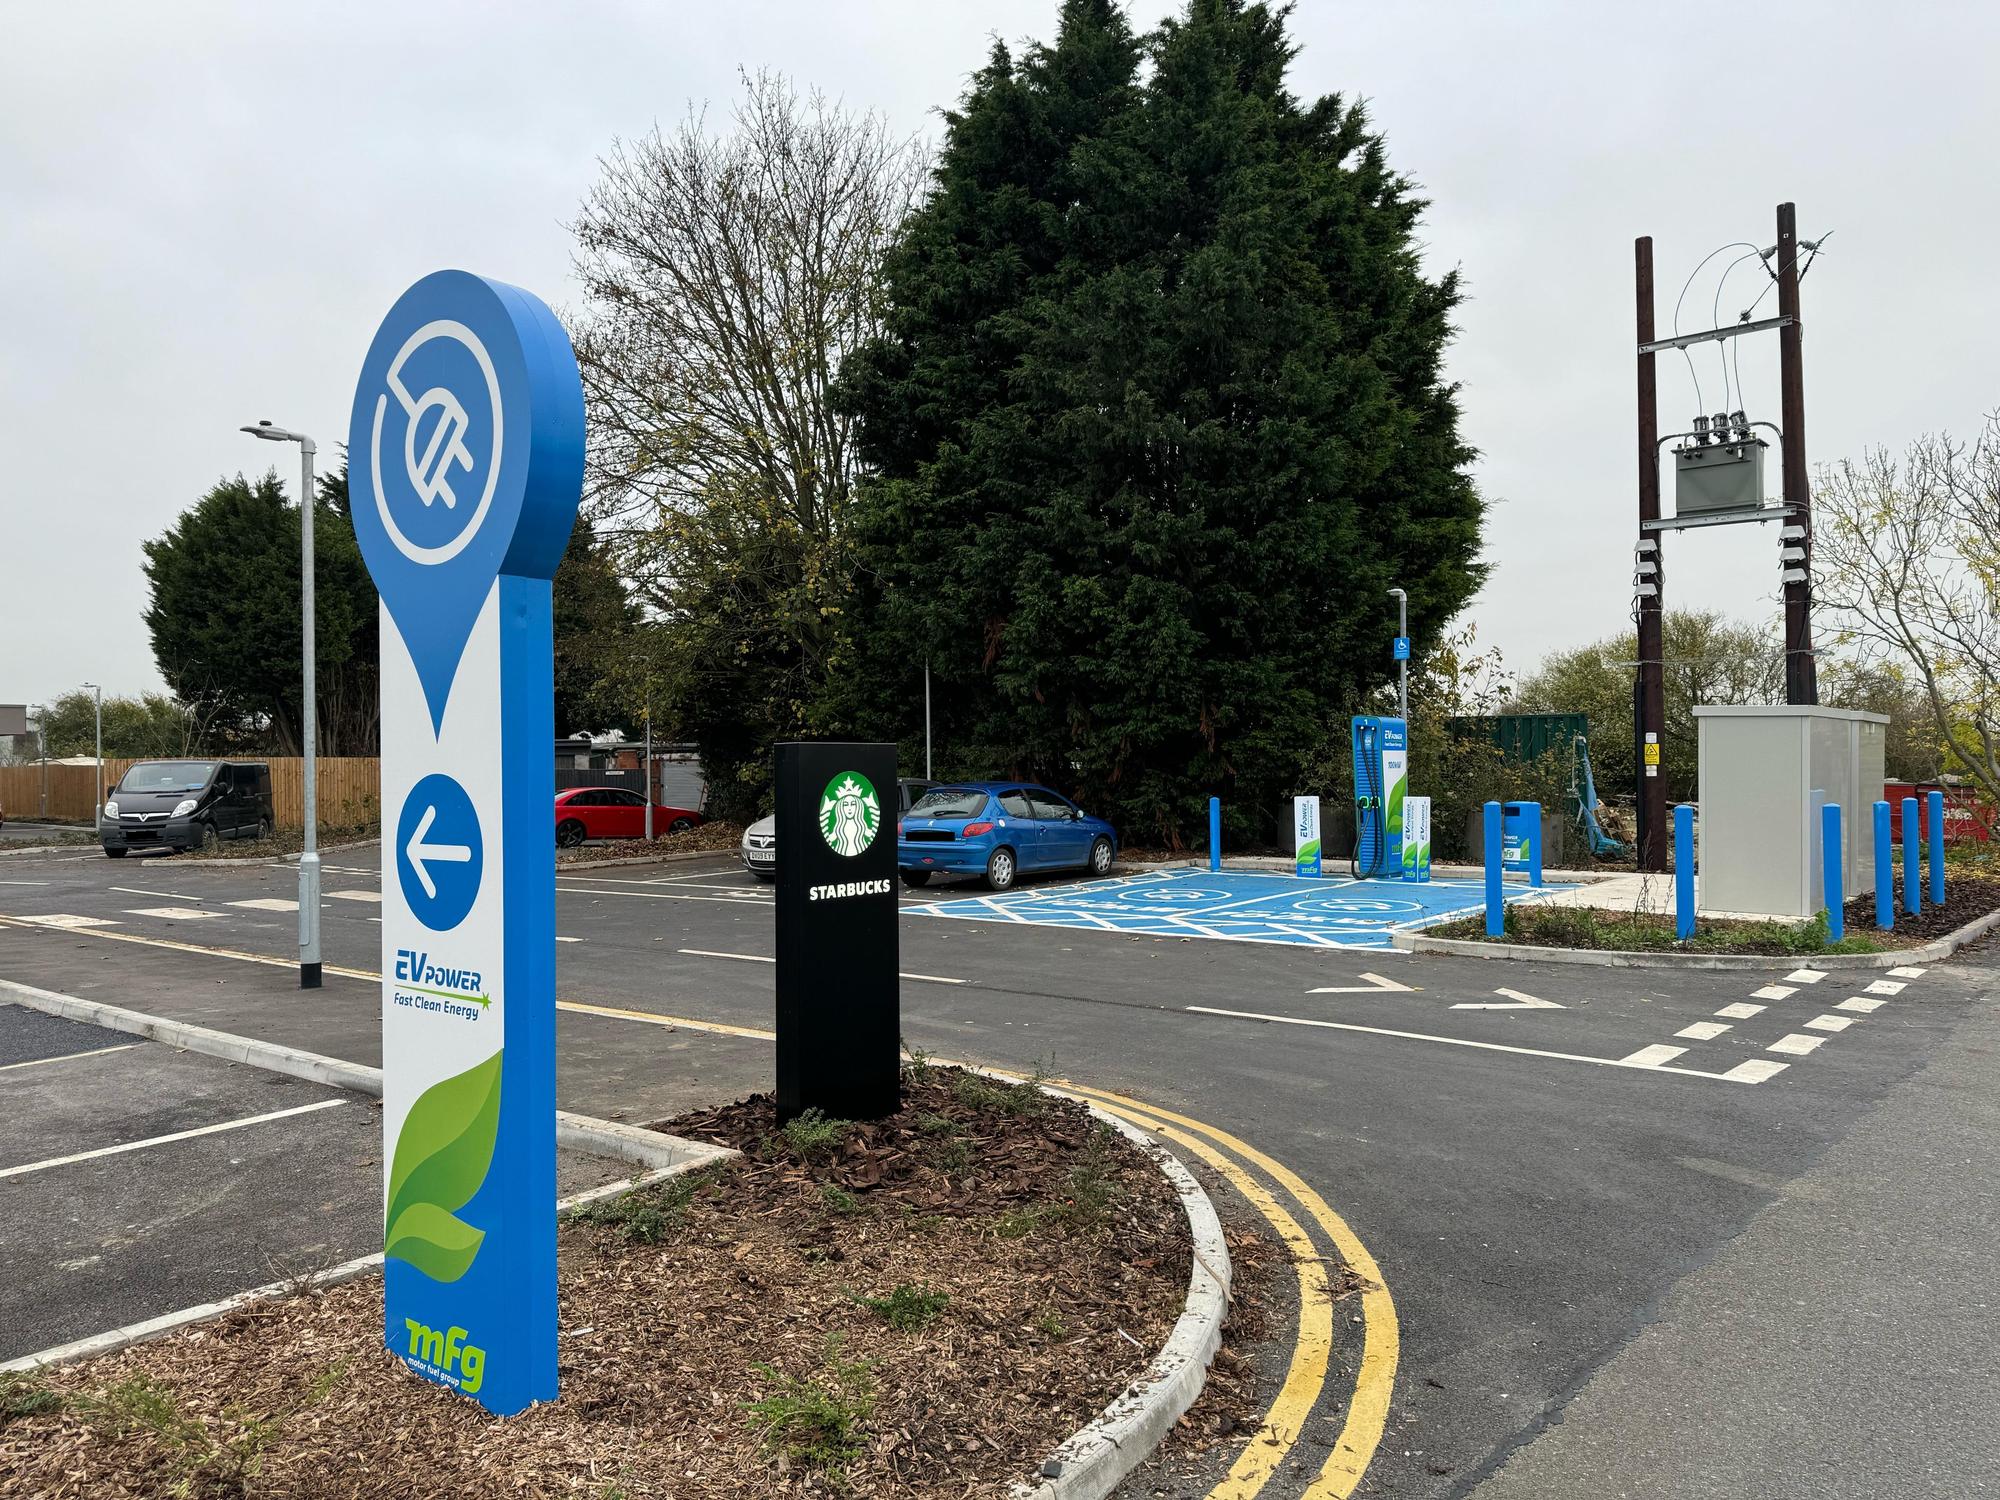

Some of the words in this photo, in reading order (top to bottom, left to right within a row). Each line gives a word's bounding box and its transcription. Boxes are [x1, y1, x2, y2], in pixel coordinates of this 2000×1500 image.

[809, 879, 891, 901] STARBUCKS
[393, 992, 413, 1007] Fast
[414, 995, 441, 1013] Clean
[443, 1001, 479, 1021] Energy
[405, 1317, 487, 1394] mfg
[407, 1357, 427, 1371] motor
[427, 1364, 440, 1378] fuel
[440, 1372, 460, 1387] group
